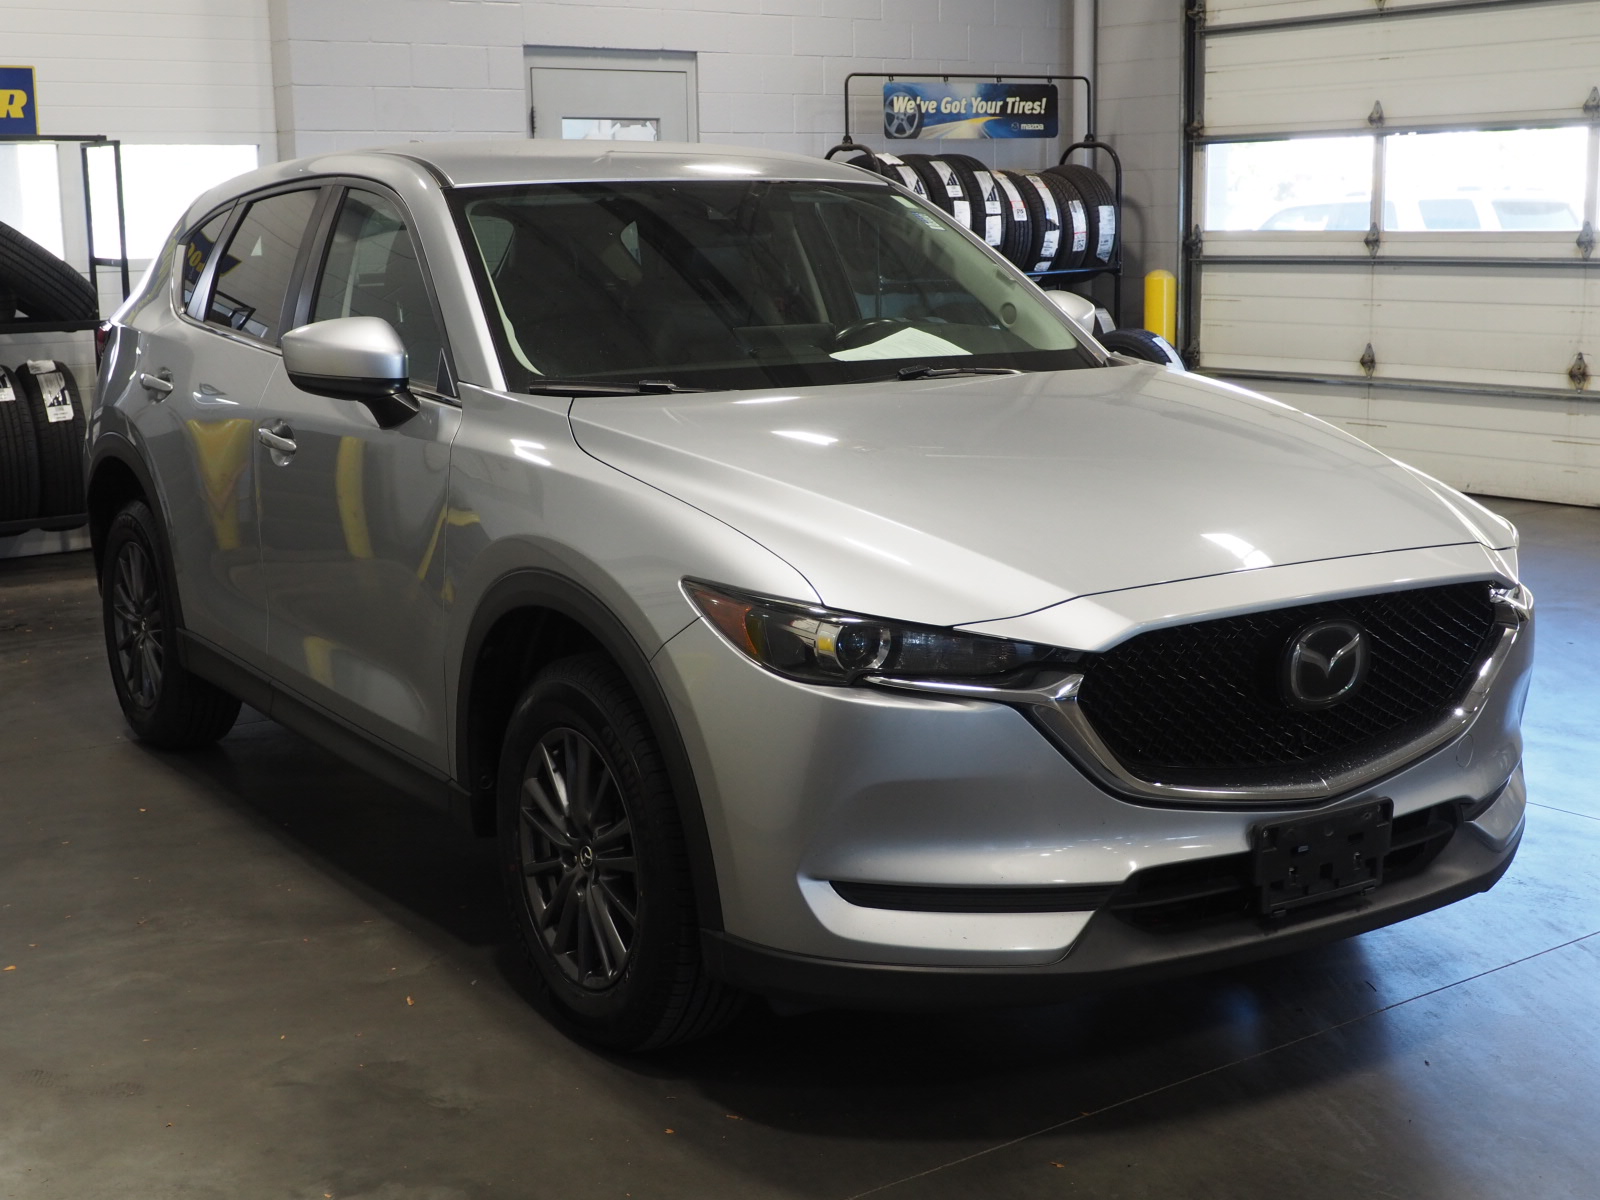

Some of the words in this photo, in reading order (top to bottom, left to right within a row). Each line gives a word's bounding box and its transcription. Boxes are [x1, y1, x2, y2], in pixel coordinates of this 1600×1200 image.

[892, 96, 937, 114] We've
[940, 97, 967, 114] Got
[971, 97, 1004, 114] Your
[1006, 97, 1048, 115] Tires!
